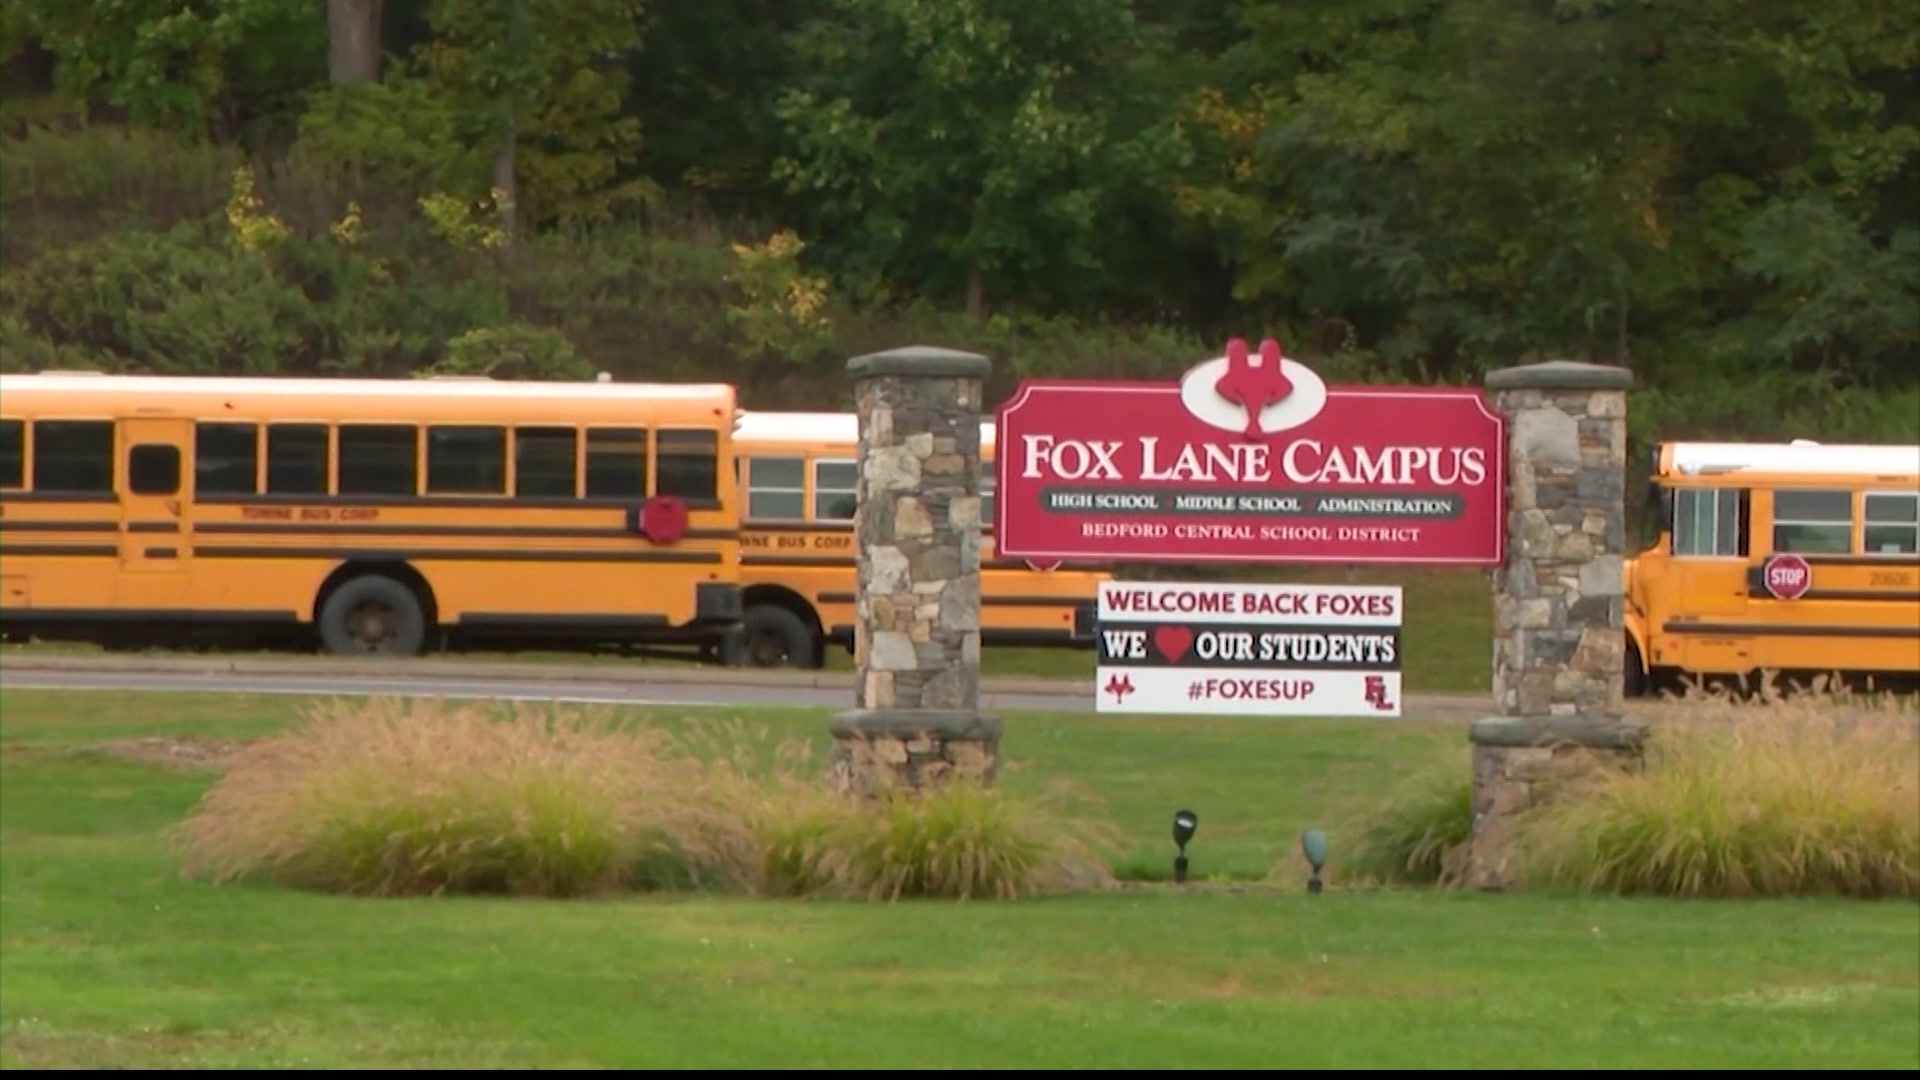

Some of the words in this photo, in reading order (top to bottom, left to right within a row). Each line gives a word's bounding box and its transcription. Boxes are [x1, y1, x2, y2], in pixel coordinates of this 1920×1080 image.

[1021, 434, 1123, 480] FOX
[1139, 436, 1271, 483] LANE
[1282, 439, 1486, 486] CAMPUS
[1051, 493, 1093, 508] HIGH
[1095, 494, 1158, 509] SCHOOL
[1176, 496, 1235, 510] MIDDLE
[1238, 497, 1301, 511] SCHOOL
[1317, 498, 1452, 513] ADMINISTRATION
[777, 535, 806, 548] BUS
[814, 536, 852, 549] CORP
[1082, 523, 1168, 538] BEDFORD
[1174, 525, 1255, 540] CENTRAL
[1260, 526, 1332, 541] SCHOOL
[1338, 527, 1421, 542] DISTRICT
[1770, 567, 1805, 585] STOP
[1106, 590, 1235, 614] WELCOME
[1242, 592, 1309, 615] BACK
[1316, 594, 1394, 616] FOXES
[1102, 630, 1147, 658] WE
[1196, 632, 1254, 660] OUR
[1259, 635, 1396, 663] STUDENTS
[1187, 679, 1315, 701] #FOXESUP
